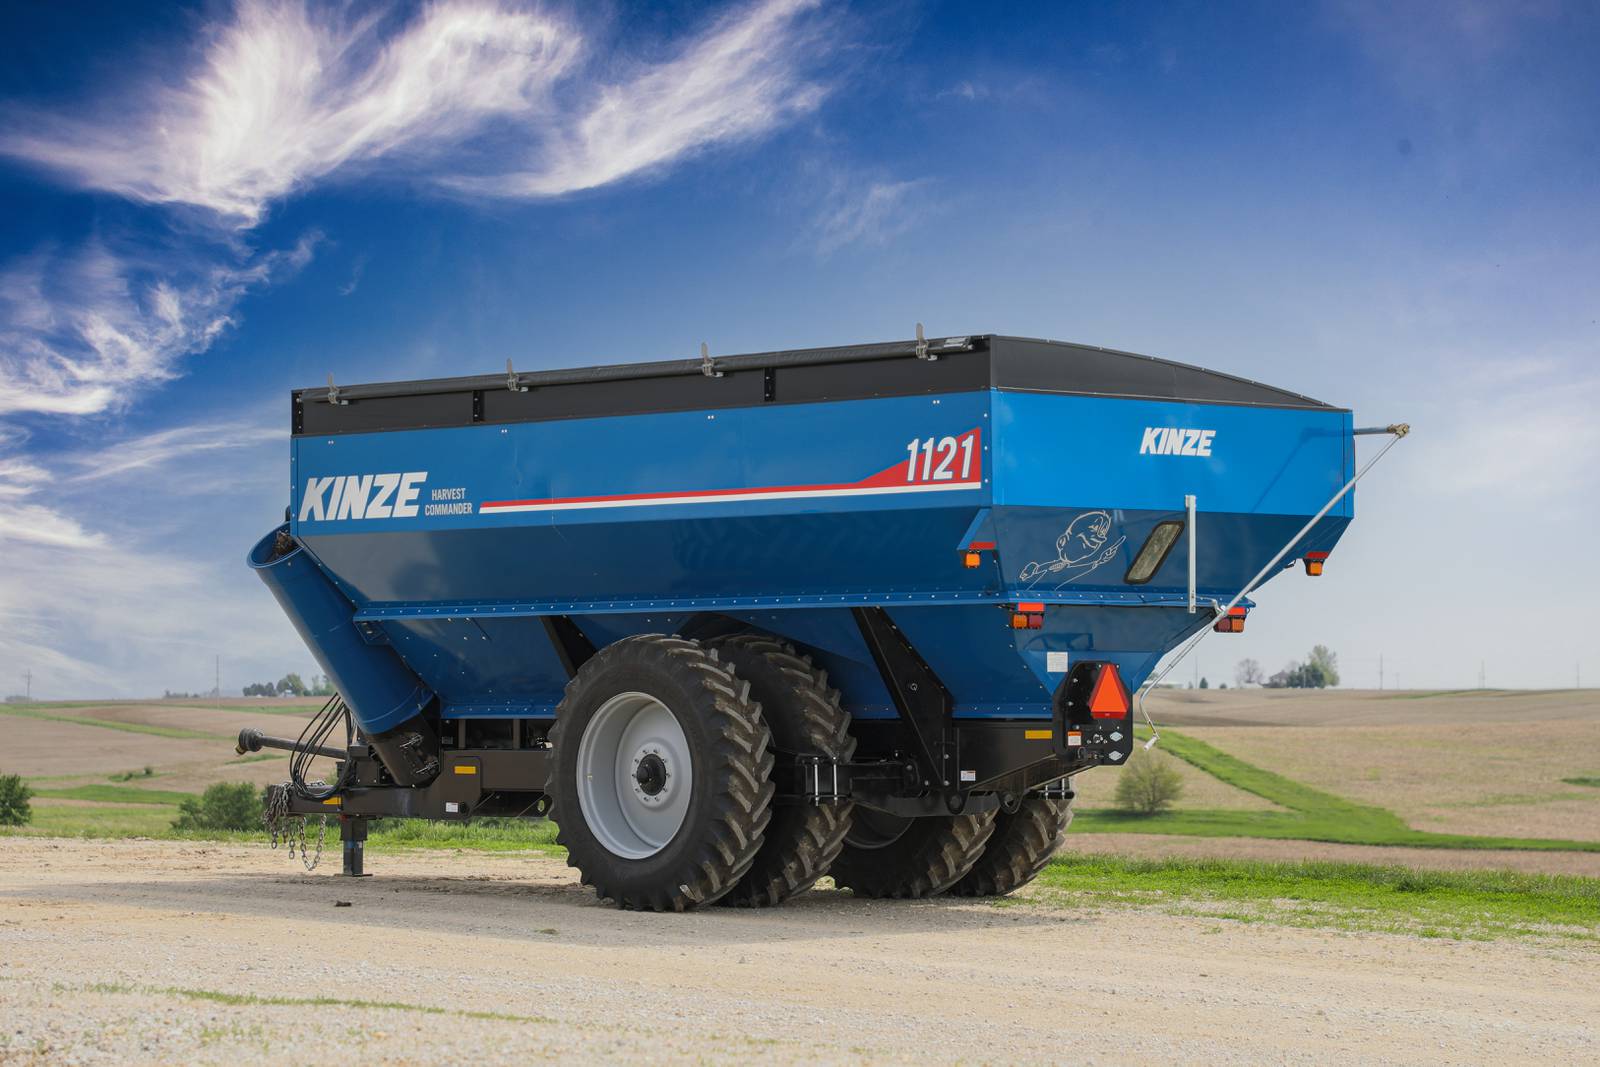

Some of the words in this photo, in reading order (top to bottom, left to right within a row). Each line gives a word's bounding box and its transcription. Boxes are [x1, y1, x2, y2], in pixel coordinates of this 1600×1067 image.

[1140, 427, 1216, 457] KINZE
[907, 435, 974, 481] 1121
[298, 471, 428, 522] KINZE
[425, 502, 472, 516] COMMANDER
[431, 488, 466, 501] HARVEST
